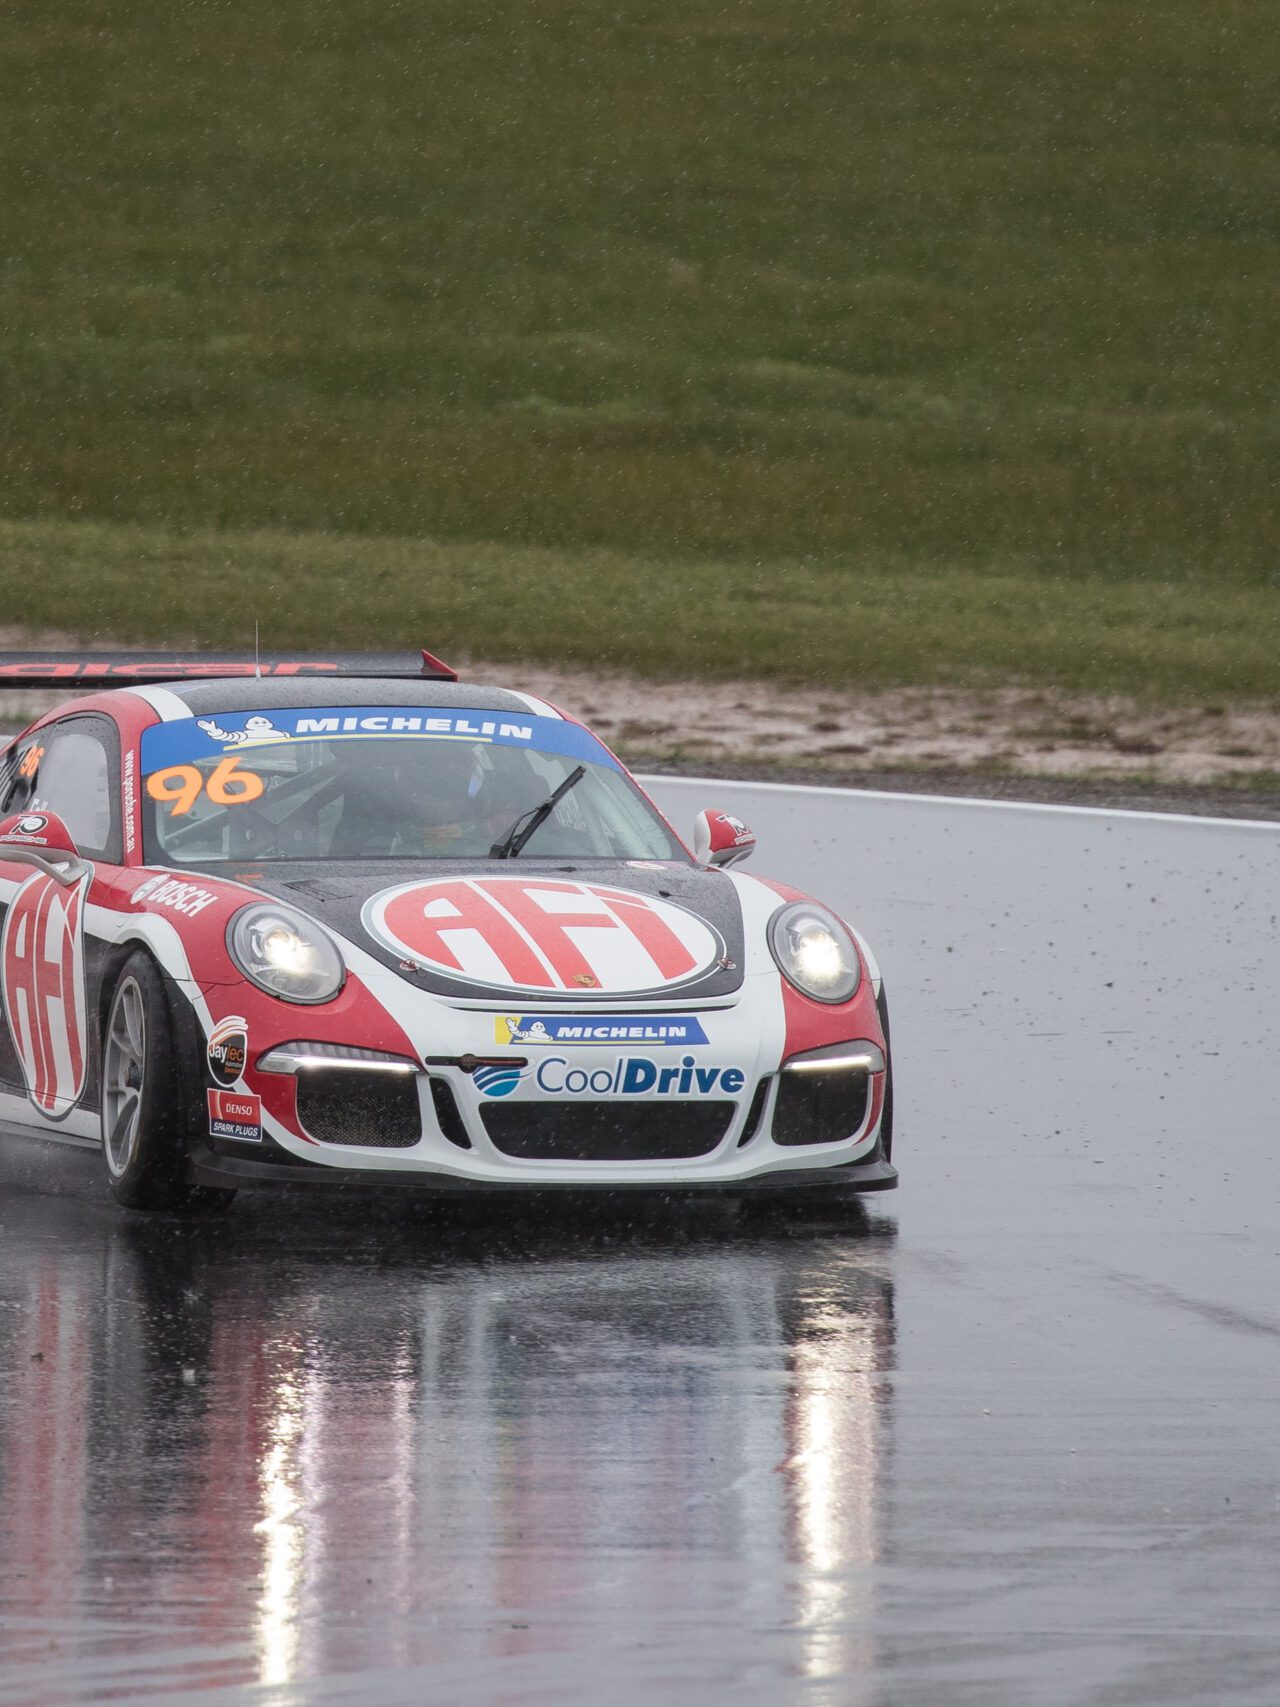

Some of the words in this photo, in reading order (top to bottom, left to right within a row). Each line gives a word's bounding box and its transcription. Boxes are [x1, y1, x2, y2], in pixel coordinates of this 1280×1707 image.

[296, 717, 532, 740] MICHELIN
[122, 750, 136, 853] www.porsche.com.au
[147, 757, 264, 816] 96
[148, 880, 218, 917] BOSCH
[384, 880, 697, 989] AFI
[5, 876, 84, 1110] AFI
[557, 1026, 686, 1038] MICHELIN
[209, 1043, 244, 1063] Jaylec
[536, 1055, 745, 1094] CoolDrive
[225, 1103, 253, 1116] DENSO
[213, 1121, 236, 1134] SPARK
[235, 1124, 259, 1137] PLUGS
